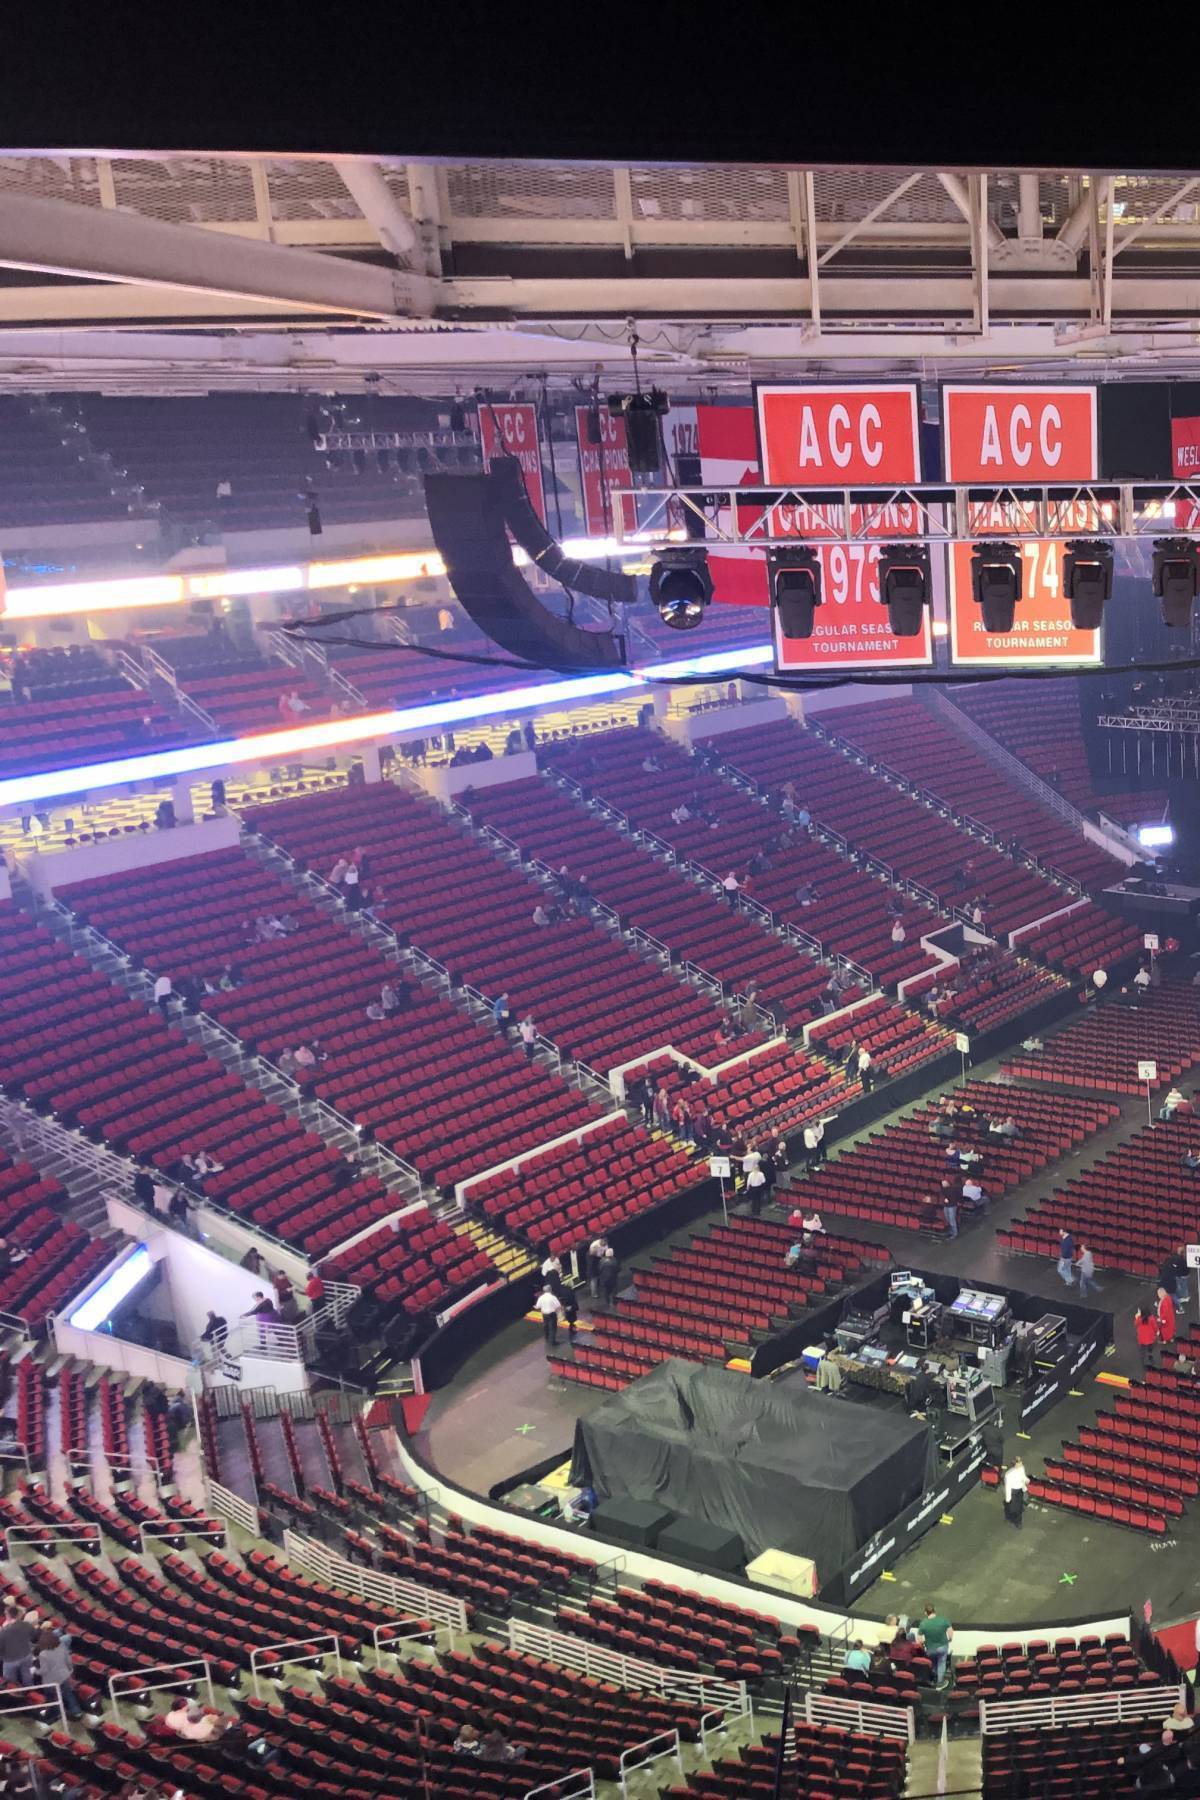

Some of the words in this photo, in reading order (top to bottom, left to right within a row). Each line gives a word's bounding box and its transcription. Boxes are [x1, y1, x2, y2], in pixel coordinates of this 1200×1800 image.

[599, 413, 617, 442] CC
[800, 403, 883, 467] ACC
[980, 404, 1062, 467] ACC
[583, 447, 629, 473] CHAPIONS
[1024, 543, 1059, 598] 74
[811, 624, 857, 637] GULAR
[862, 624, 893, 635] SEAS
[1033, 620, 1074, 632] SEASO
[813, 639, 899, 653] TOURNAMENT
[986, 636, 1068, 649] TOURNAMENT
